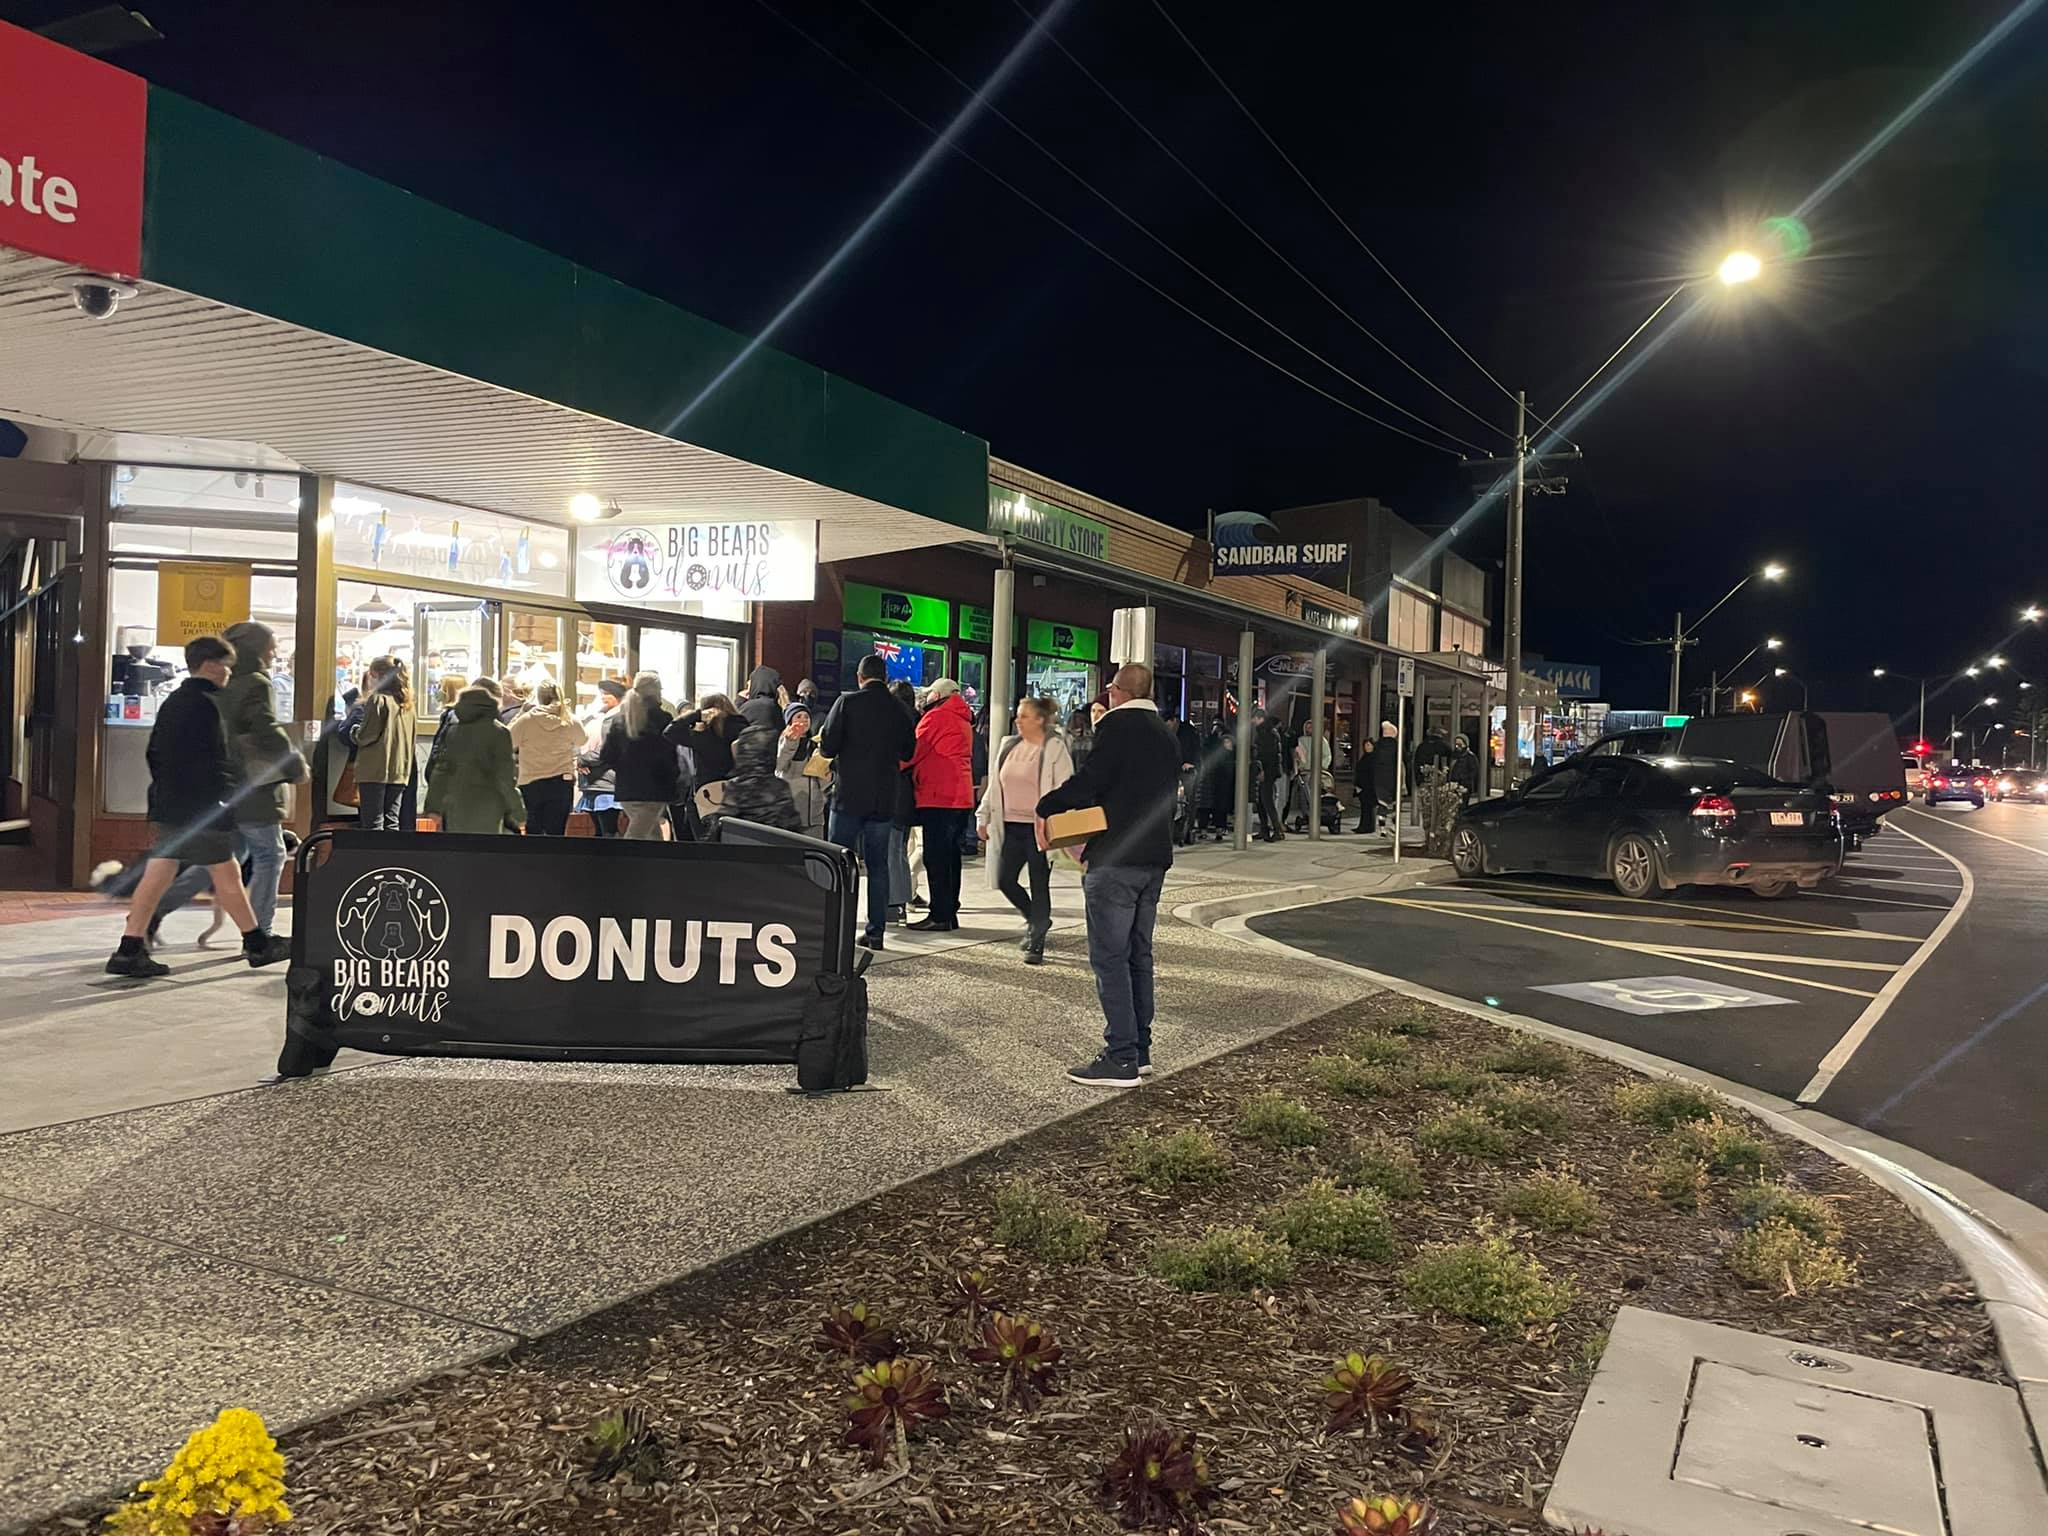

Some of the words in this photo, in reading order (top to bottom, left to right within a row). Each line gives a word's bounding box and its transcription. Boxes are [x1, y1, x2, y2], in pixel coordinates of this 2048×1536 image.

[668, 526, 698, 557] BIG
[708, 524, 770, 557] BEARS
[1069, 523, 1104, 559] STORE
[1217, 546, 1297, 566] SANDBAR
[1302, 543, 1347, 563] SURF
[489, 914, 797, 988] DONUTS
[334, 959, 371, 987] BIG
[381, 959, 450, 988] BEARS
[331, 976, 451, 1023] donuts
